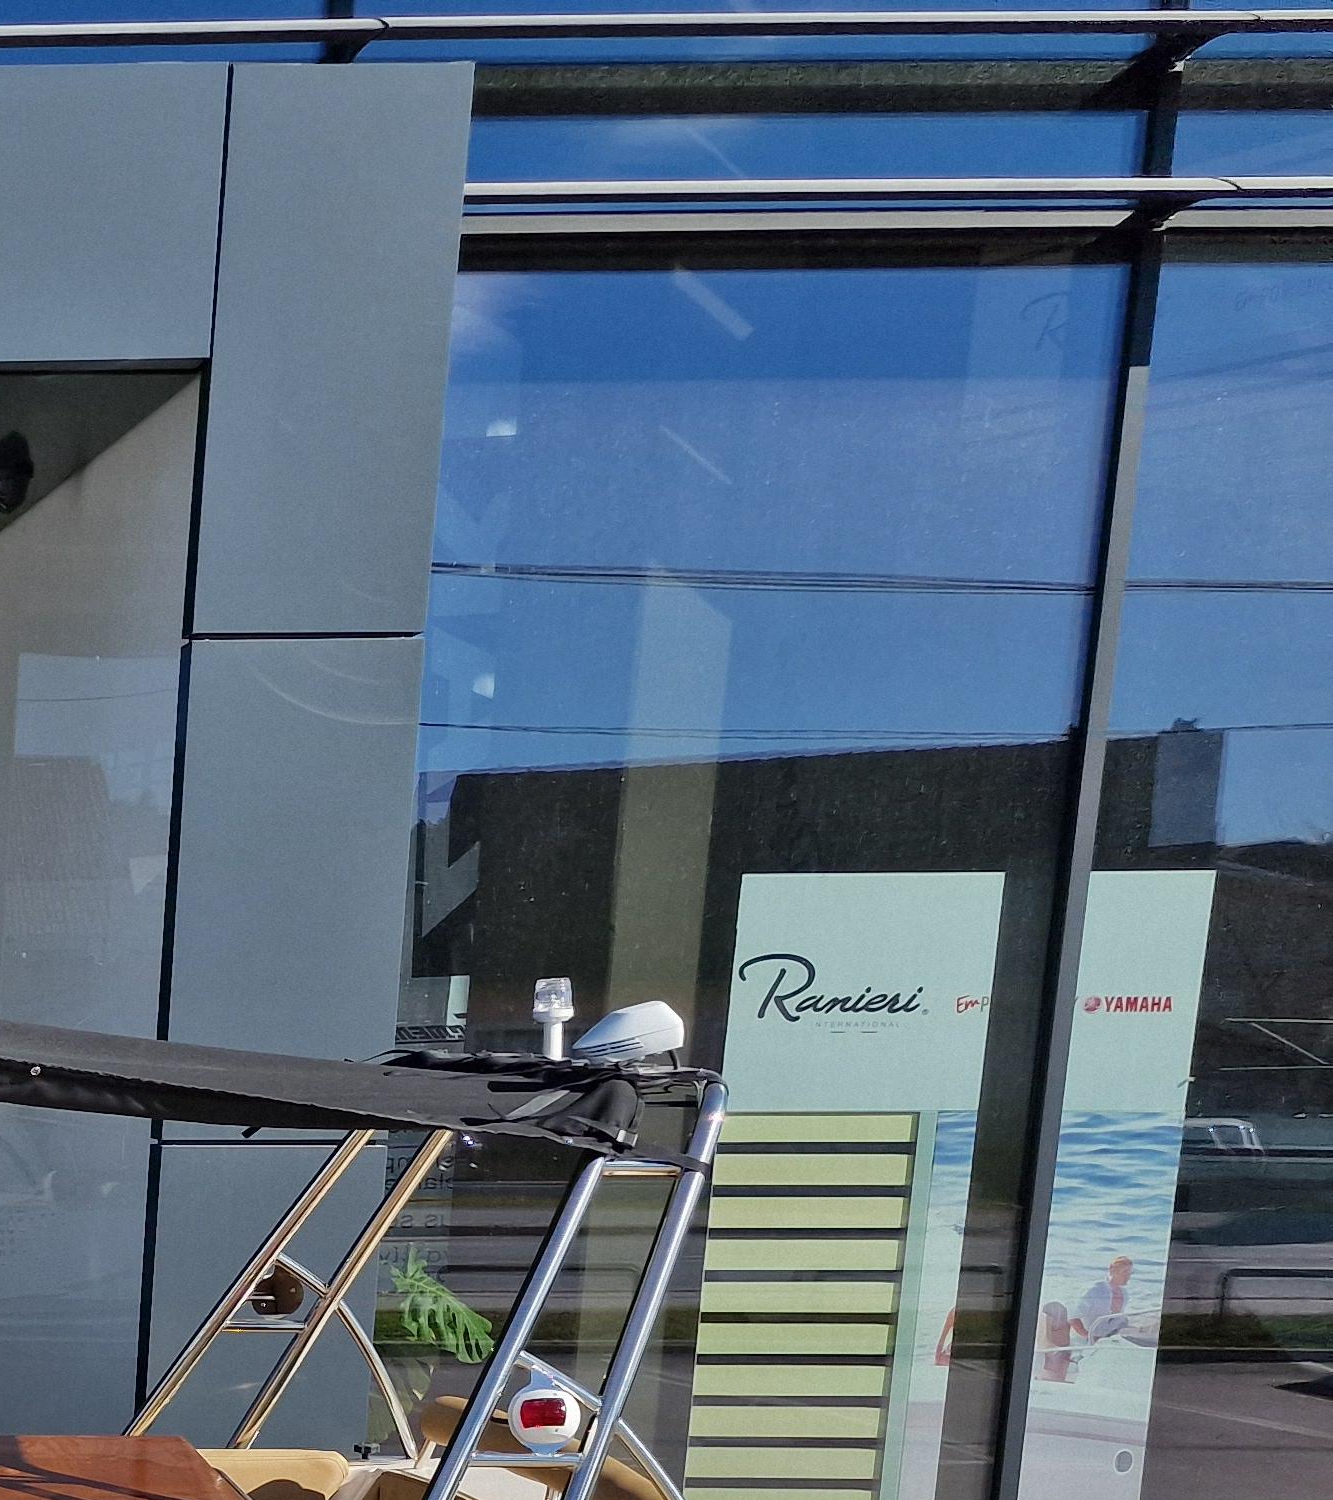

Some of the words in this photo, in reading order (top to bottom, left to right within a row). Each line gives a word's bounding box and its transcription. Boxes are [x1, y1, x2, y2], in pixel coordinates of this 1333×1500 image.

[738, 953, 924, 1022] Ranieri
[1104, 996, 1173, 1013] YAMAHA
[813, 1020, 902, 1029] NTERNATIONAL
